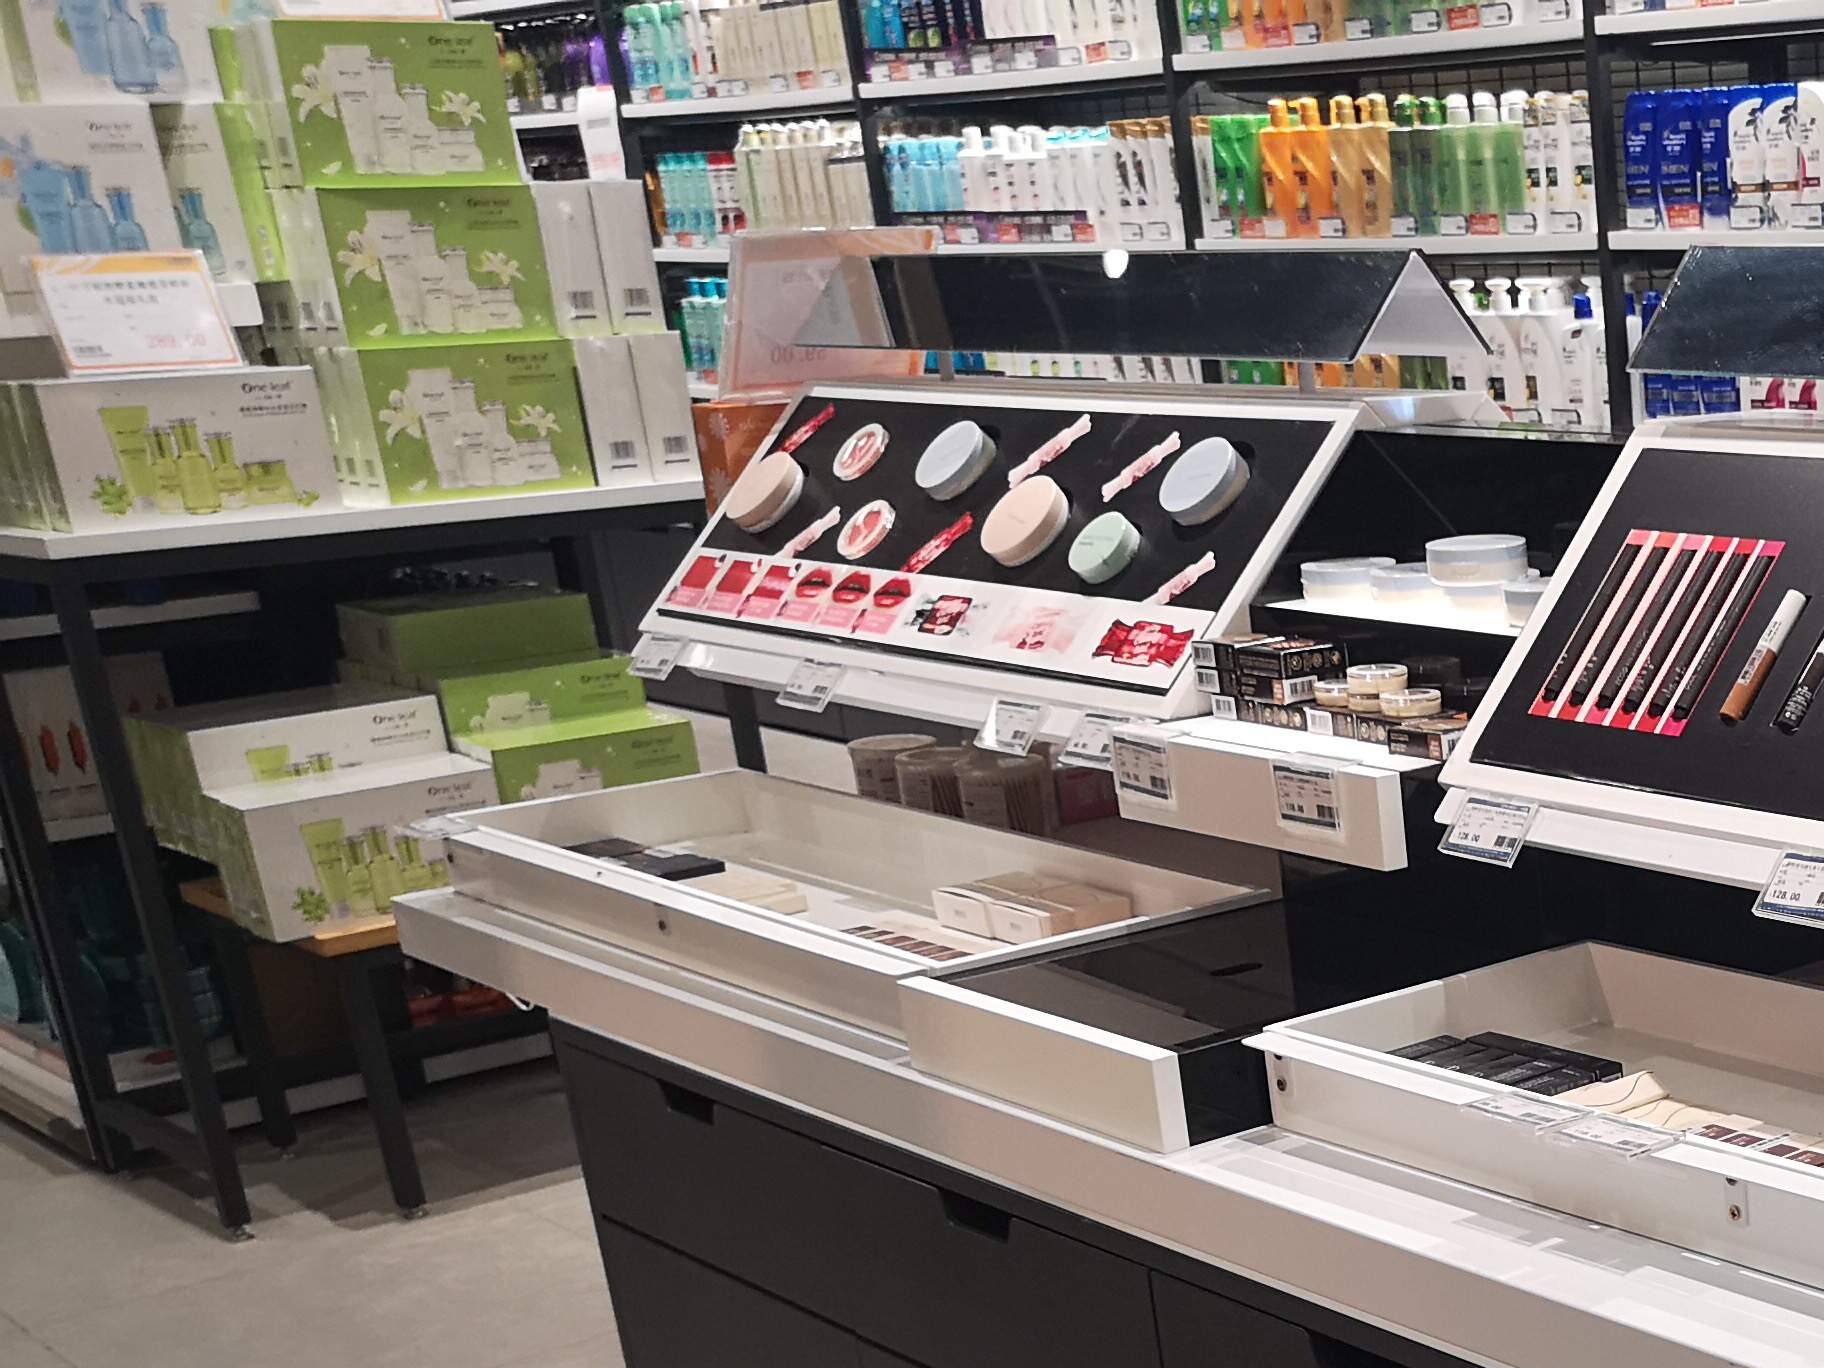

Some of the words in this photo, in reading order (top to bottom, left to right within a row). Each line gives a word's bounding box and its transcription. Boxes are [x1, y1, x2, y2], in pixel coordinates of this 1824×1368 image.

[241, 381, 267, 395] One
[269, 380, 291, 393] leaf
[1772, 889, 1801, 902] 128.00
